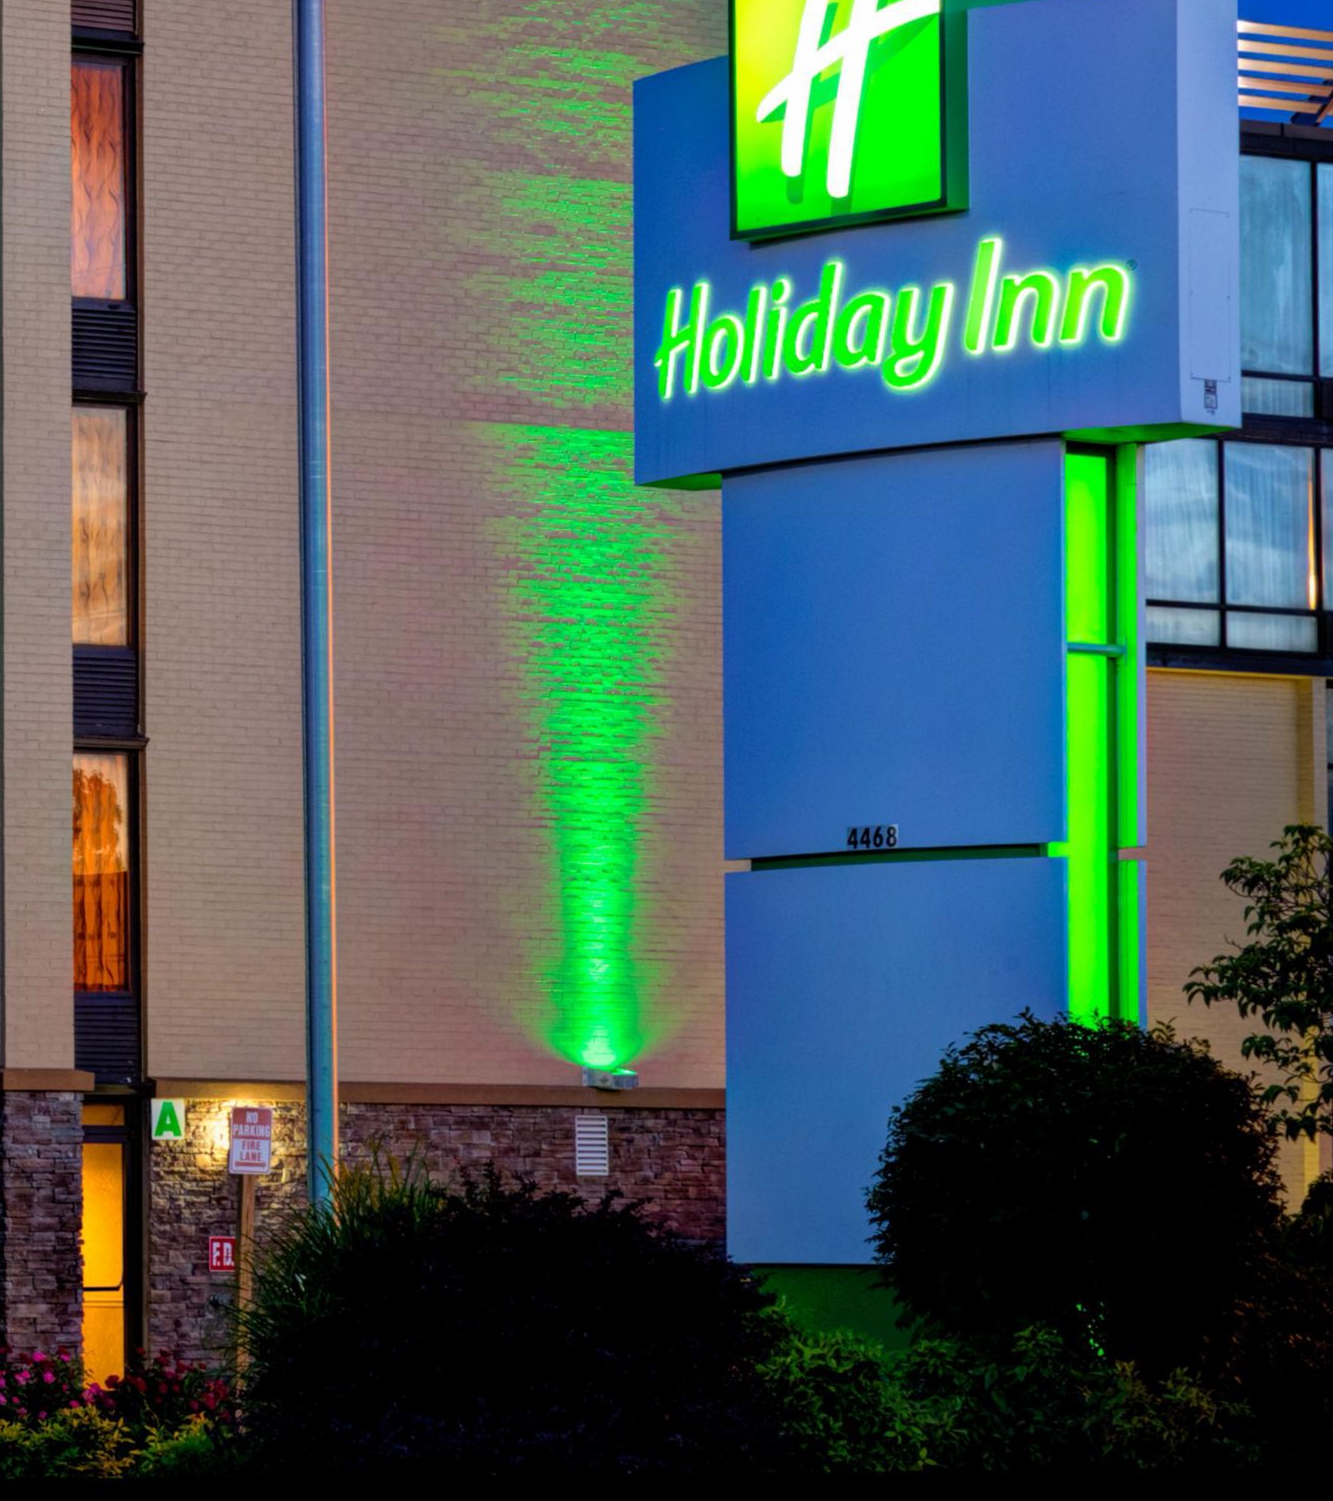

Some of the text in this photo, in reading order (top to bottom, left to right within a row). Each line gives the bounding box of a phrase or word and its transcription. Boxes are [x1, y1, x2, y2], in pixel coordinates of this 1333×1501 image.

[654, 237, 1130, 400] Holiday Inn
[847, 826, 897, 849] 4468
[154, 1101, 182, 1137] A
[246, 1111, 259, 1124] NO
[233, 1124, 271, 1138] PARKING
[241, 1140, 261, 1151] FIRE
[239, 1151, 262, 1162] LANE
